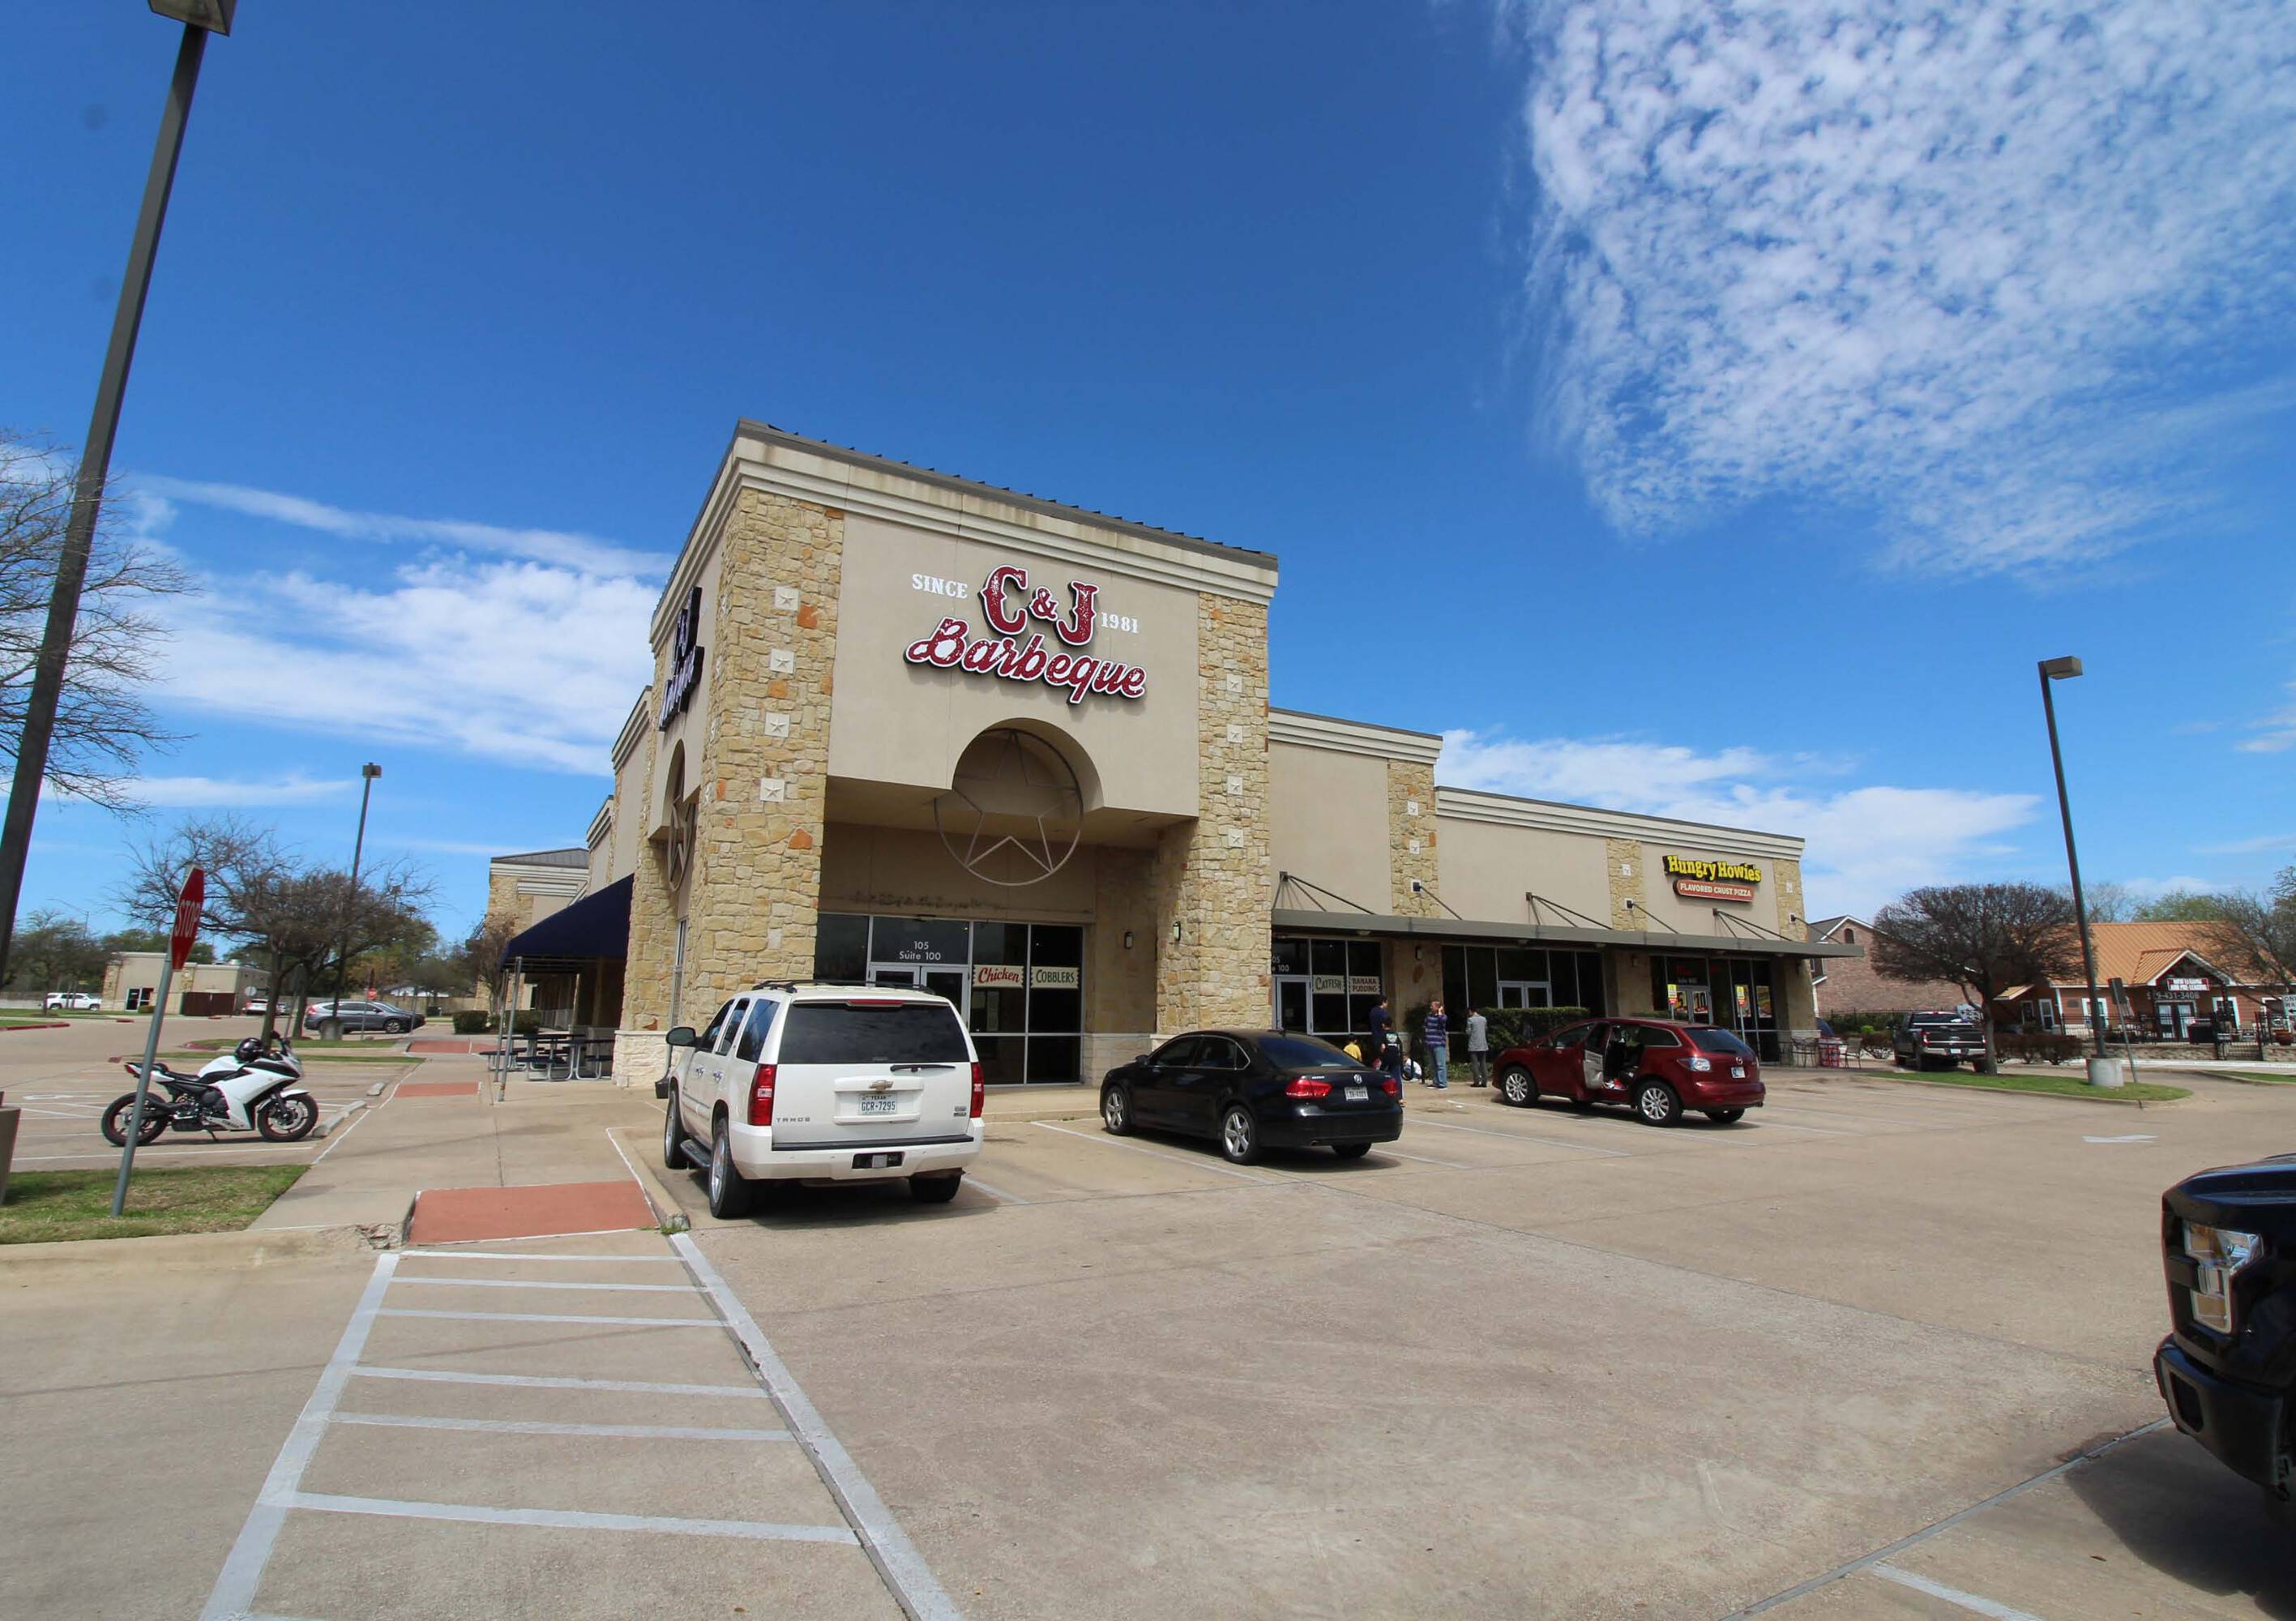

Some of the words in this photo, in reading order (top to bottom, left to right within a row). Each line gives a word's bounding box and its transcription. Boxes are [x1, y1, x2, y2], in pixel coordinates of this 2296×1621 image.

[911, 573, 968, 599] SINCE
[1101, 611, 1140, 634] 1981
[904, 616, 1147, 704] Barbeque
[1666, 855, 1717, 882] Hungry
[1680, 883, 1713, 893] FLAVORED
[1713, 887, 1734, 895] CRUST
[1734, 888, 1752, 897] PIZZA
[913, 940, 930, 950] 105
[900, 950, 921, 960] Suite
[925, 952, 941, 960] 100
[1272, 956, 1281, 964] 05
[977, 967, 1021, 984] Chicken
[1036, 969, 1075, 984] COBBLERS
[1352, 985, 1378, 993] PUDDING
